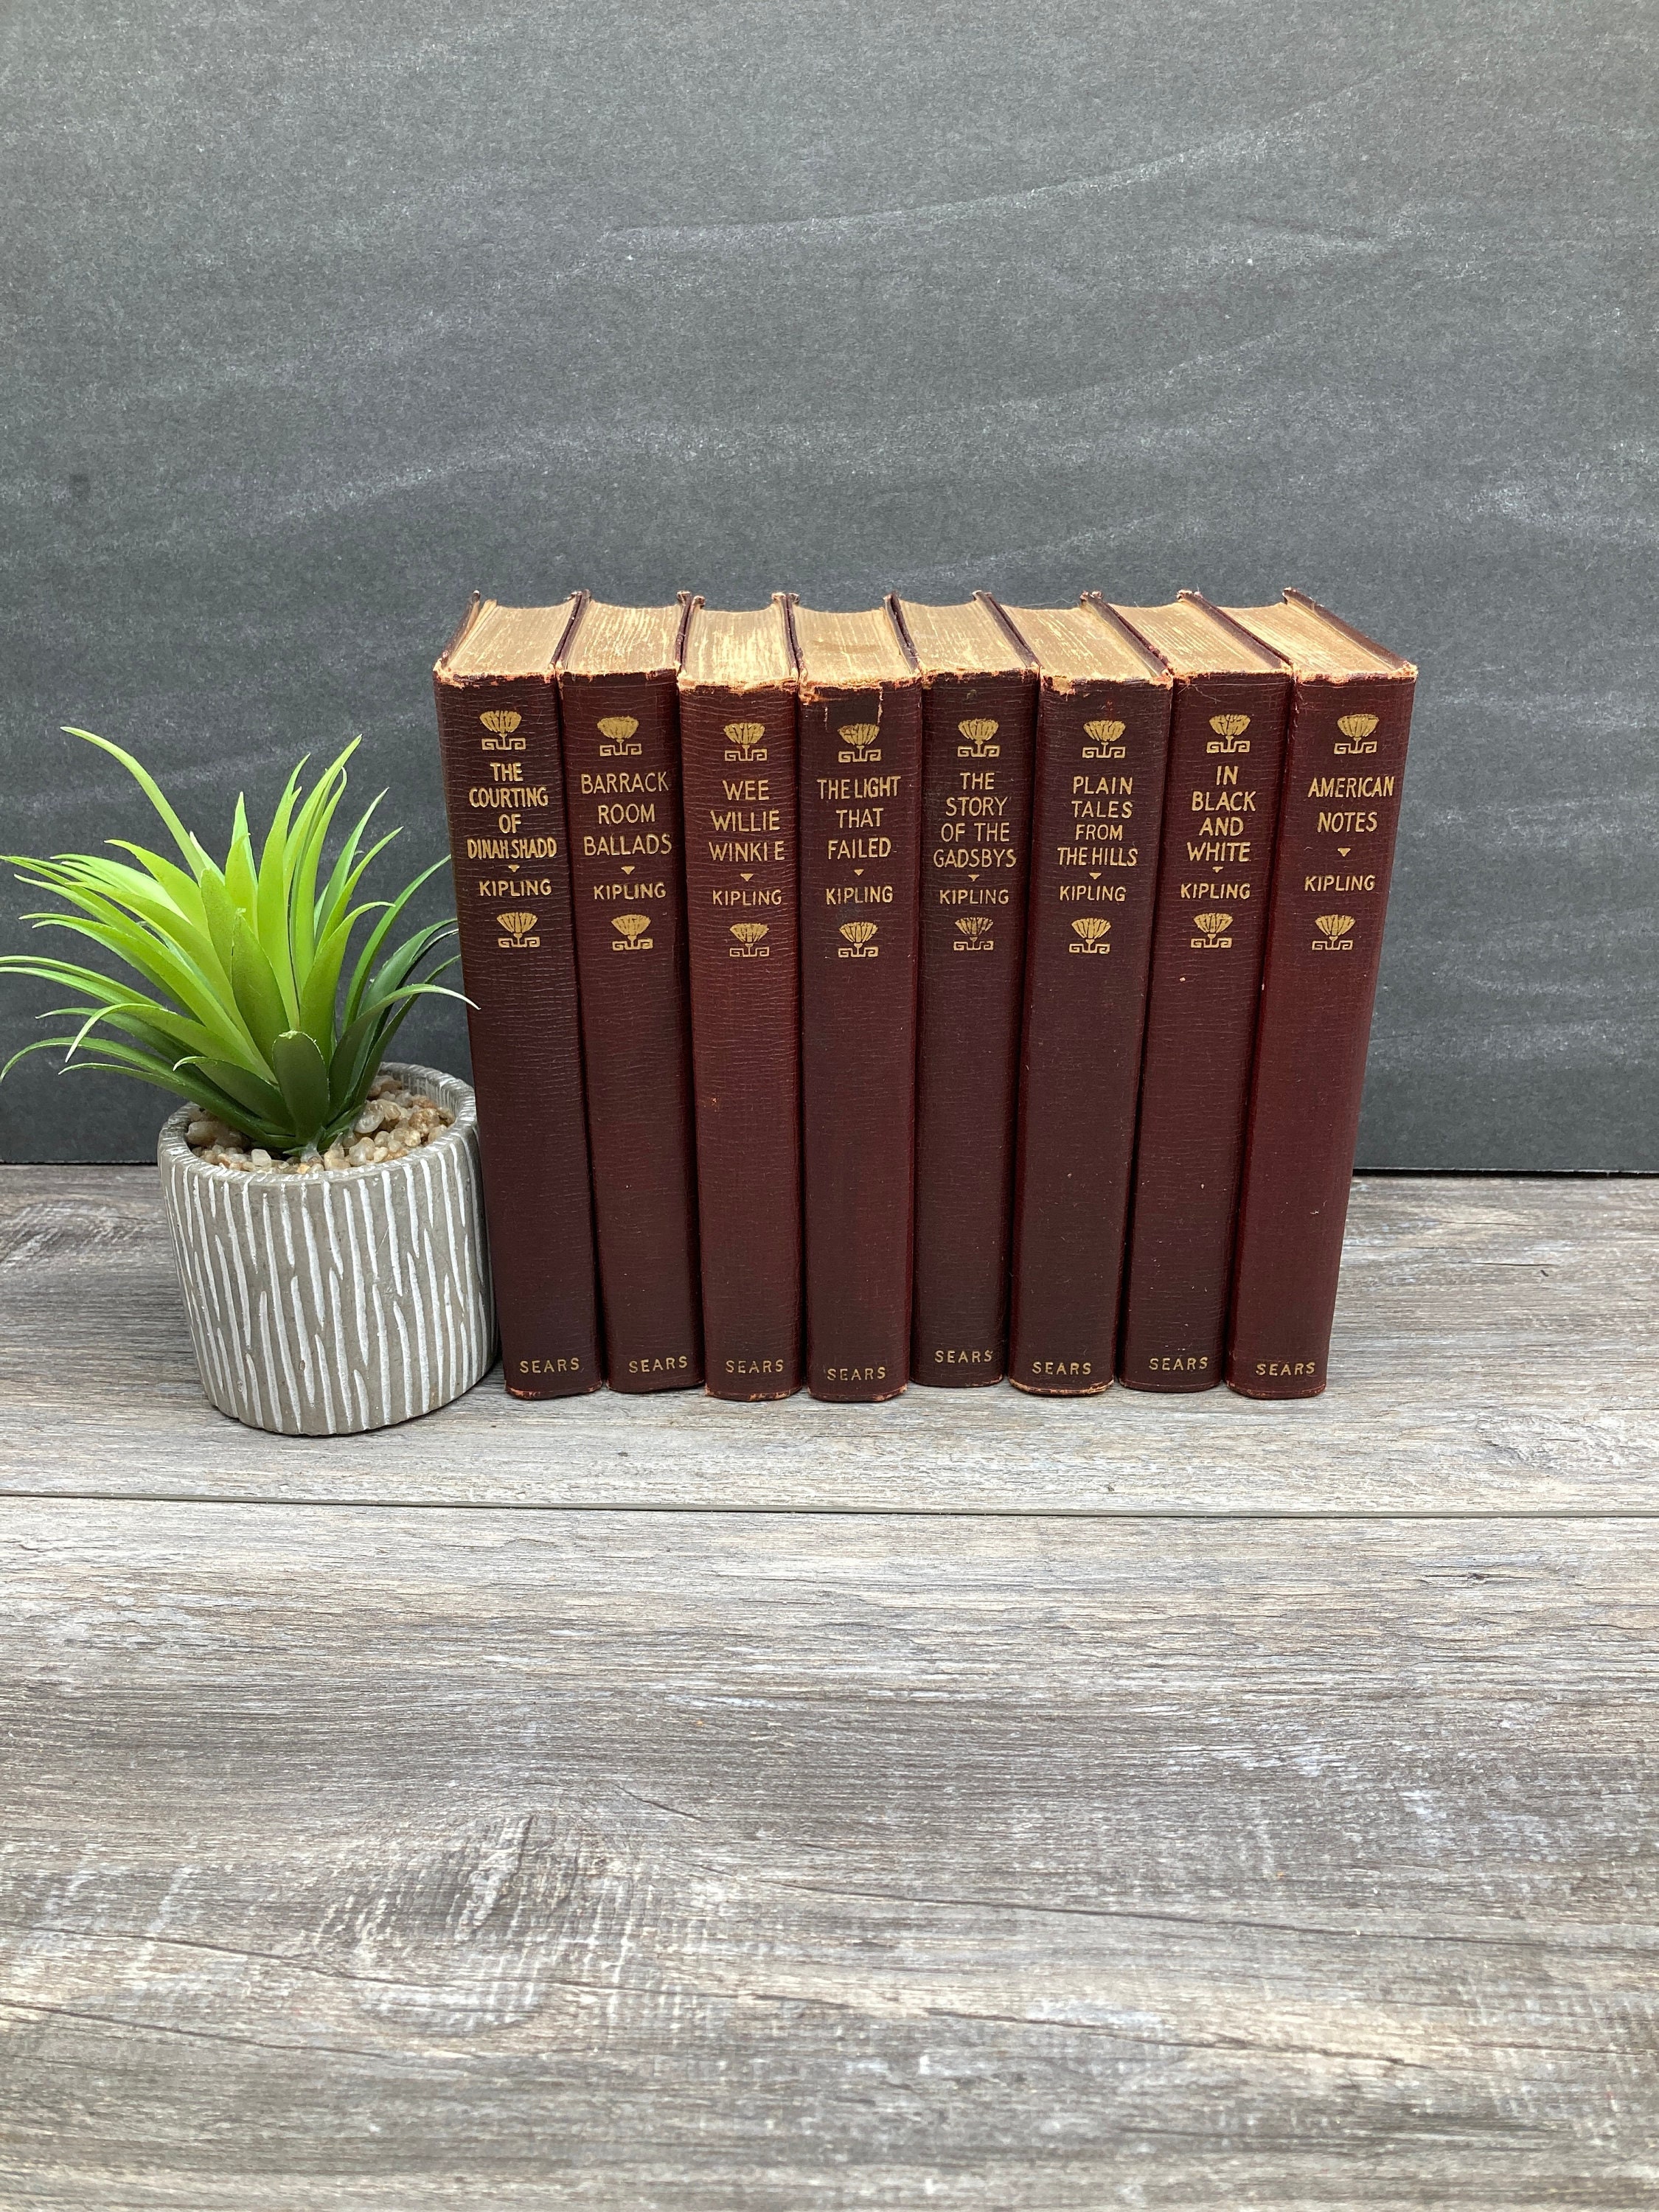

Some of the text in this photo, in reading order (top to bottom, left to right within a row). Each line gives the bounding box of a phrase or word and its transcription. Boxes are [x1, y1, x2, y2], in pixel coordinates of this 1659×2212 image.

[489, 762, 524, 782] THE
[959, 772, 995, 790] THE
[1216, 765, 1239, 786] IN
[581, 771, 669, 794] BARRACK
[722, 779, 770, 801] WEE
[816, 776, 902, 800] THE LIGHT
[1073, 776, 1133, 795] PLAIN
[1307, 775, 1395, 799] AMERICAN
[468, 786, 549, 808] COURTING
[945, 796, 1008, 816] STORY
[1192, 790, 1256, 812] BLACK
[597, 803, 655, 825] ROOM
[835, 807, 884, 829] THAT
[1071, 800, 1133, 818] TALES
[498, 813, 522, 834] OF
[709, 809, 781, 832] WILLIE
[1198, 816, 1244, 837] AND
[1317, 811, 1378, 833] NOTES
[941, 822, 1010, 842] OF THE
[1075, 824, 1123, 841] FROM
[583, 832, 672, 856] BALLADS
[708, 840, 785, 862] WINKIE
[828, 837, 891, 860] FAILED
[1186, 841, 1251, 862] WHITE
[933, 848, 1017, 868] GADSBYS
[1057, 846, 1138, 867] THE HILLS
[479, 878, 552, 897] KIPLING
[593, 881, 667, 900] KIPLING
[1180, 883, 1251, 900] KIPLING
[1304, 874, 1376, 892] KIPLING
[712, 888, 782, 906] KIPLING
[825, 885, 894, 905] KIPLING
[939, 888, 1009, 905] KIPLING
[1060, 885, 1127, 902] KIPLING
[519, 1357, 580, 1374] SEARS
[628, 1355, 688, 1374] SEARS
[934, 1349, 992, 1363] SEARS
[1148, 1356, 1208, 1371] SEARS
[725, 1359, 784, 1374] SEARS
[827, 1366, 886, 1381] SEARS
[1032, 1361, 1091, 1375] SEARS
[1255, 1361, 1315, 1377] SEARS
